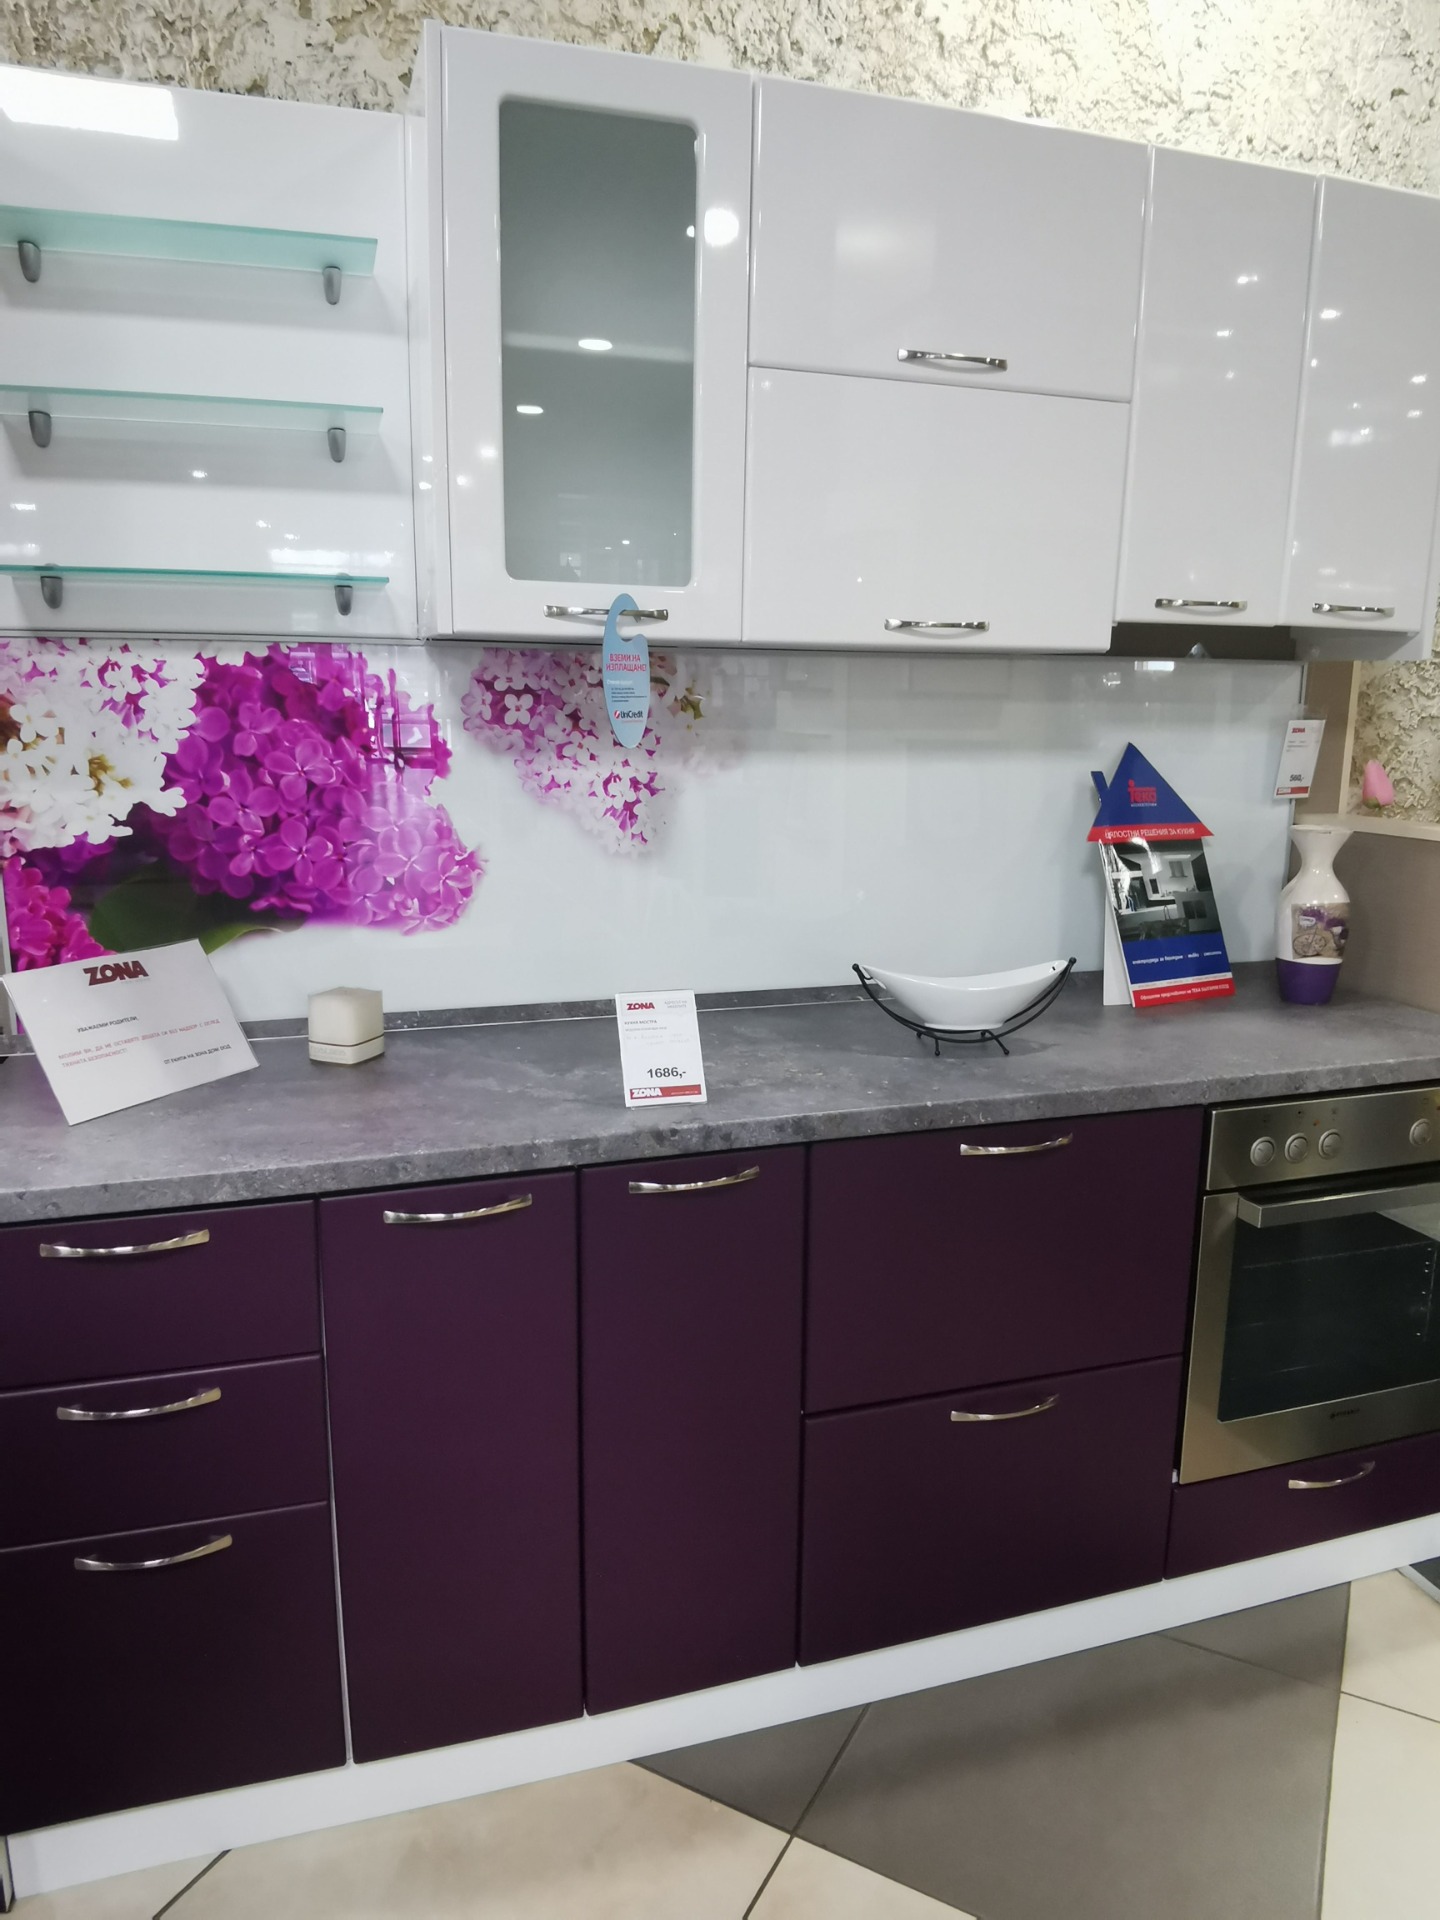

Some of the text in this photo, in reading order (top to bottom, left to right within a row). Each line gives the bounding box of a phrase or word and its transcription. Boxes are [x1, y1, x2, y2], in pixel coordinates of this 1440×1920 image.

[82, 960, 149, 986] ZONA
[626, 1002, 655, 1011] ZONA
[632, 1087, 663, 1098] ZONA
